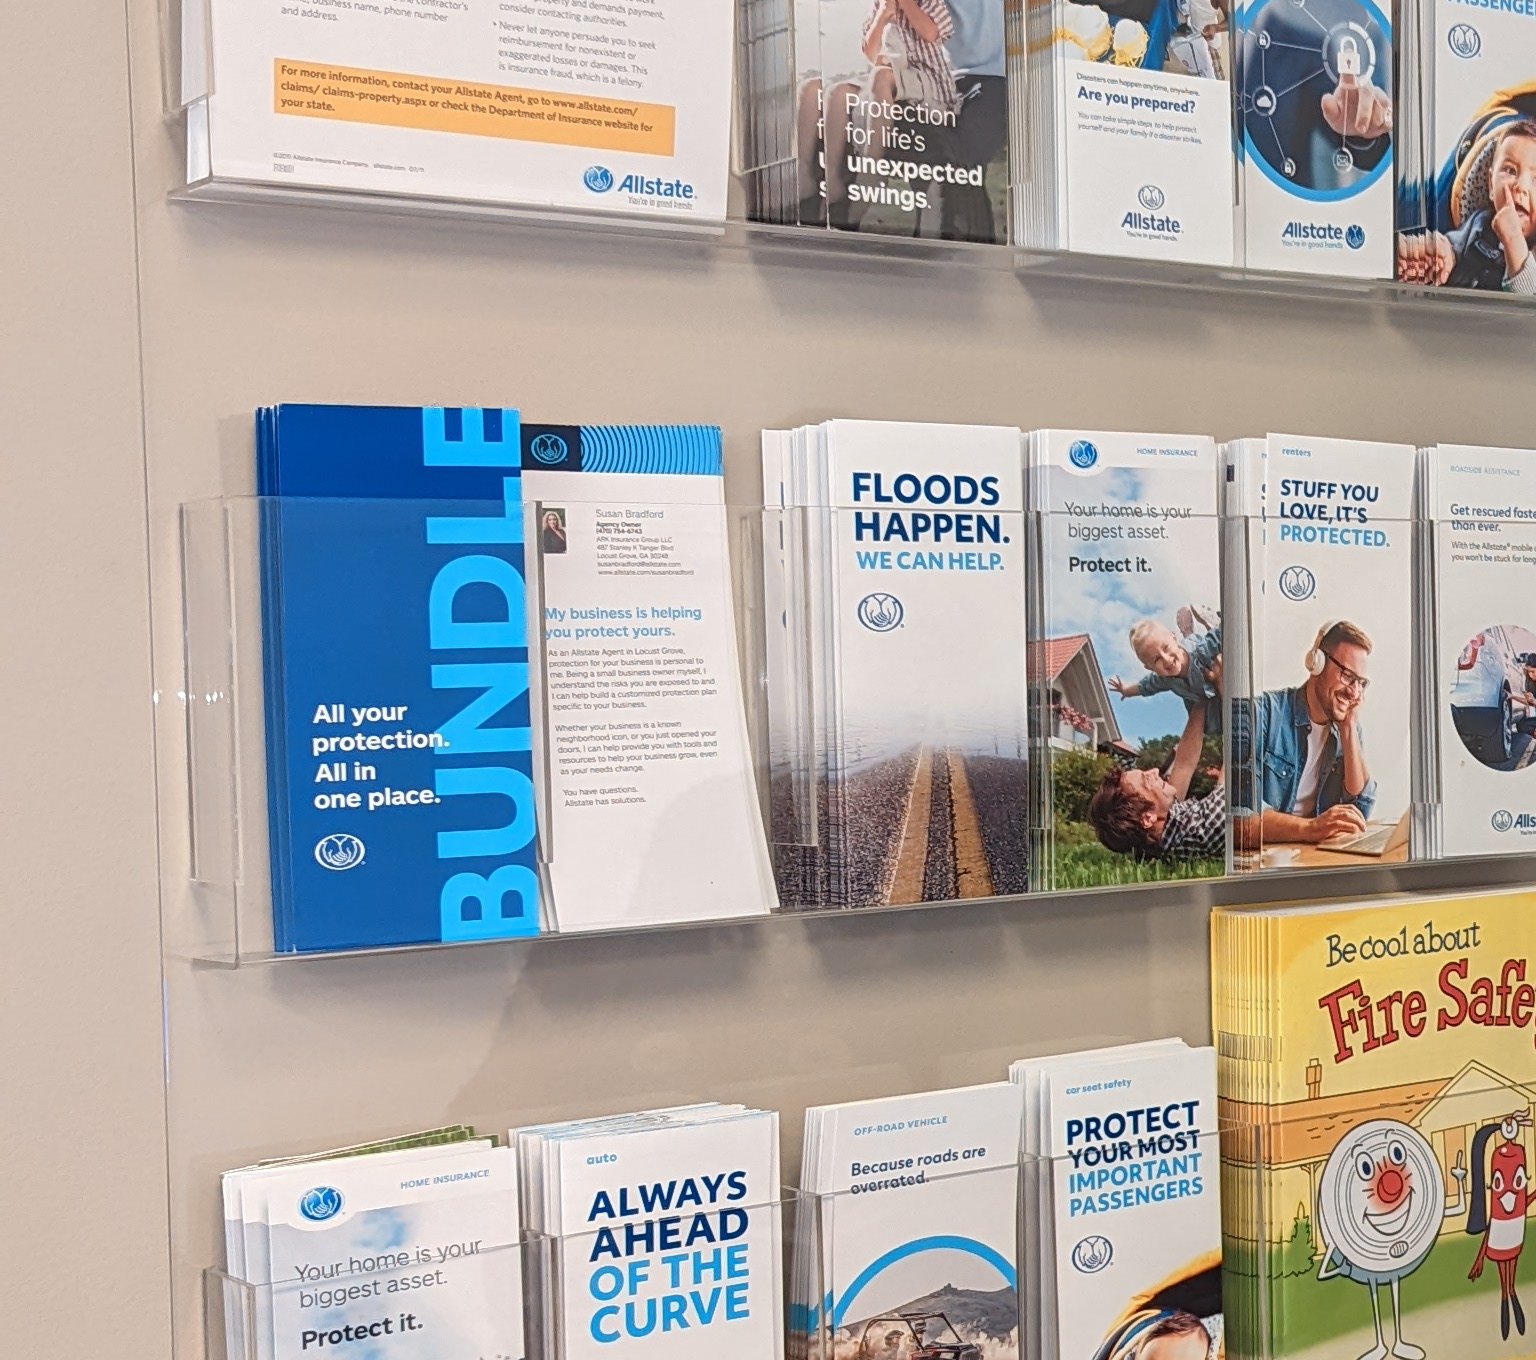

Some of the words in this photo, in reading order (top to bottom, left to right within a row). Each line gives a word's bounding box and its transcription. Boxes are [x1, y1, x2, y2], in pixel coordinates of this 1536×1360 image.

[282, 65, 298, 75] For
[300, 70, 326, 79] more
[329, 71, 390, 88] information,
[392, 81, 428, 92] contact
[431, 86, 452, 94] your
[455, 86, 492, 99] Allstate
[495, 91, 525, 104] Agent,
[528, 97, 539, 105] go
[541, 97, 550, 106] to
[281, 99, 304, 107] your
[307, 101, 335, 111] state.
[846, 93, 958, 129] Protection
[1078, 86, 1102, 101] Are
[1105, 93, 1128, 106] you
[1131, 97, 1195, 113] prepared?
[442, 100, 469, 111] check
[471, 104, 486, 113] the
[489, 105, 544, 120] Department
[547, 112, 556, 121] of
[559, 113, 602, 126] Insurance
[604, 120, 638, 130] website
[641, 122, 653, 132] for
[846, 122, 874, 146] for
[882, 126, 926, 151] life's
[847, 156, 983, 189] unexpected
[848, 186, 931, 211] swings.
[1160, 448, 1198, 457] INSURANCE
[853, 472, 999, 506] FLOODS
[1281, 480, 1337, 498] STUFF
[1341, 484, 1378, 502] YOU
[596, 509, 623, 518] Susan
[626, 509, 663, 519] Bradford
[1064, 501, 1097, 517] Your
[1101, 502, 1142, 517] home
[1147, 504, 1157, 518] is
[1161, 507, 1192, 521] your
[1281, 502, 1333, 524] LOVE,
[1337, 506, 1368, 523] IT'S
[1451, 504, 1469, 515] Get
[1472, 507, 1511, 517] rescued
[856, 512, 1010, 543] HAPPEN.
[1068, 523, 1123, 541] biggest
[1128, 526, 1168, 538] asset.
[1282, 525, 1390, 546] PROTECTED.
[1451, 519, 1475, 531] than
[1478, 522, 1501, 532] ever.
[856, 551, 892, 570] WE
[896, 552, 943, 569] CAN
[949, 553, 1004, 571] HELP.
[1070, 557, 1131, 572] Protect
[1136, 557, 1151, 572] it.
[544, 608, 566, 622] My
[569, 607, 632, 620] business
[636, 607, 647, 618] is
[652, 607, 701, 620] helping
[544, 627, 571, 640] you
[576, 626, 629, 639] protect
[632, 626, 674, 638] yours.
[422, 406, 539, 943] BUNDLE
[313, 704, 344, 723] All
[352, 706, 407, 725] your
[312, 731, 450, 757] protection.
[314, 763, 346, 783] All
[354, 762, 375, 781] in
[315, 793, 361, 808] one
[369, 786, 441, 809] place.
[1326, 934, 1356, 967] Be
[1360, 927, 1409, 960] cool
[1413, 922, 1480, 954] about
[1319, 979, 1427, 1064] Fire
[1083, 1083, 1101, 1092] seat
[1104, 1080, 1131, 1089] safety
[855, 1122, 904, 1136] OFF-ROAD
[908, 1116, 947, 1128] VEHICLE
[1068, 1101, 1199, 1145] PROTECT
[587, 1154, 617, 1164] auto
[1068, 1140, 1136, 1168] YOUR
[1138, 1129, 1200, 1158] MOST
[852, 1159, 913, 1176] Because
[918, 1149, 958, 1166] roads
[962, 1148, 986, 1159] are
[1070, 1153, 1202, 1194] IMPORTANT
[401, 1177, 432, 1189] HOME
[434, 1170, 490, 1184] INSURANCE
[851, 1171, 929, 1194] overrated.
[588, 1171, 746, 1221] ALWAYS
[1071, 1177, 1202, 1216] PASSENGERS
[588, 1208, 750, 1262] AHEAD
[294, 1262, 342, 1282] Your
[349, 1251, 410, 1272] home
[416, 1246, 431, 1262] is
[438, 1240, 482, 1263] your
[590, 1260, 650, 1300] OF
[662, 1244, 749, 1288] THE
[300, 1280, 380, 1308] biggest
[387, 1270, 447, 1292] asset.
[591, 1282, 749, 1342] CURVE
[302, 1318, 392, 1350] Protect
[400, 1314, 422, 1331] it.
